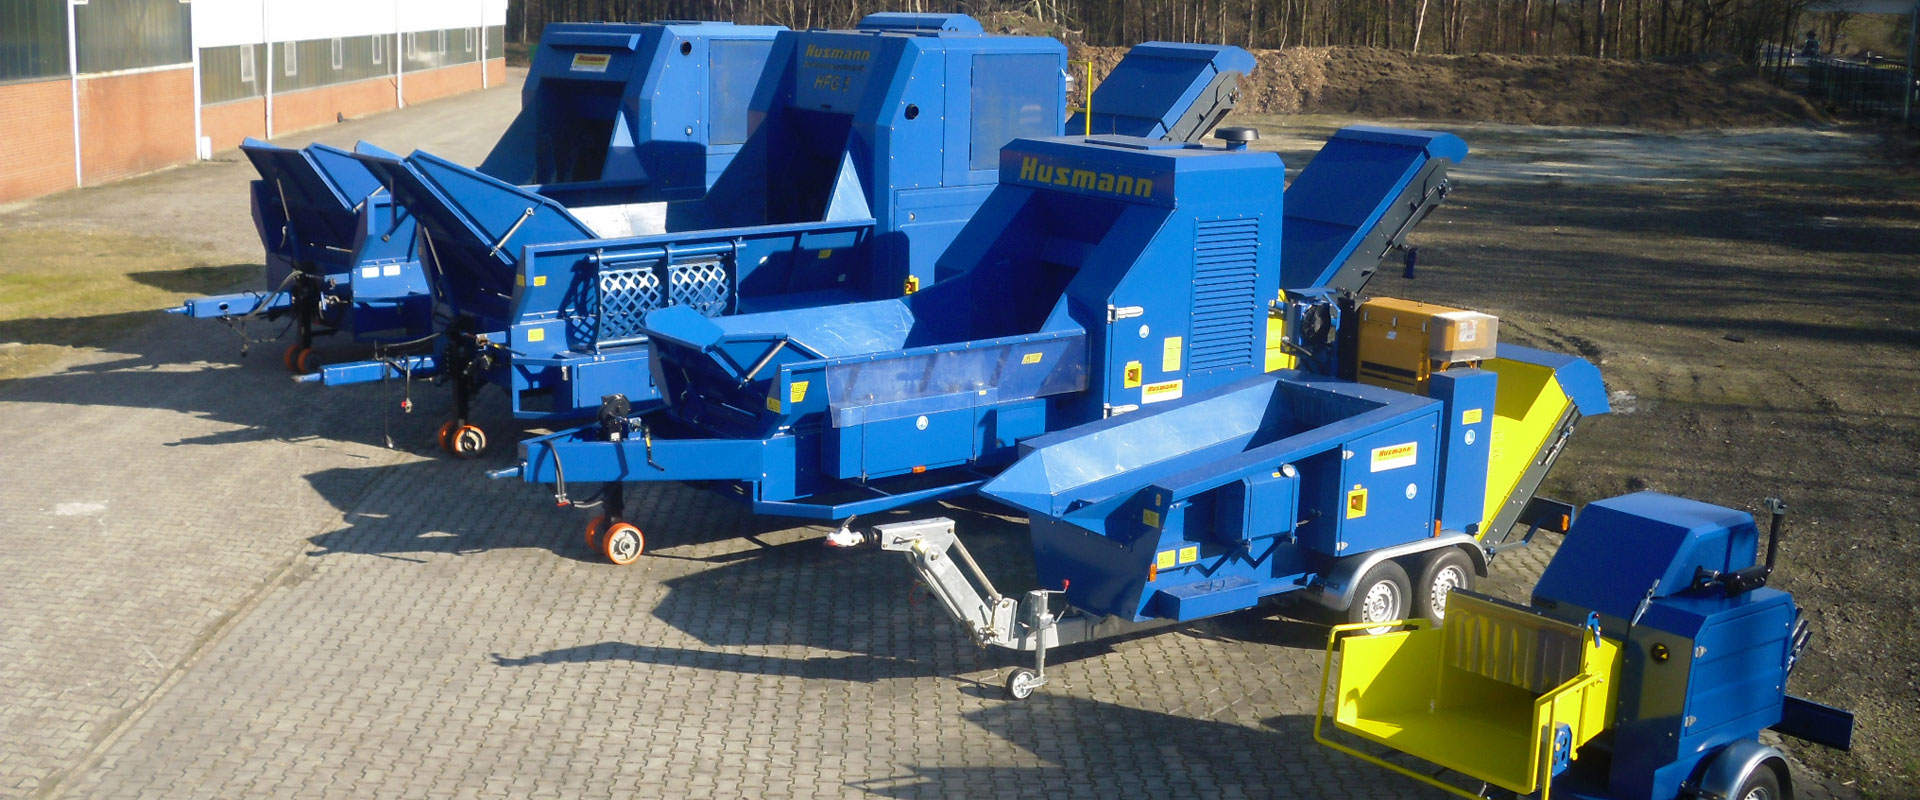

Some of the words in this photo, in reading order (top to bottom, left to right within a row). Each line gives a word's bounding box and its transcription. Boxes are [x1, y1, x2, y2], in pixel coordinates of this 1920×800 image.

[805, 43, 870, 61] Husmann
[1020, 156, 1153, 198] Husmann
[1378, 446, 1412, 457] Husmann
